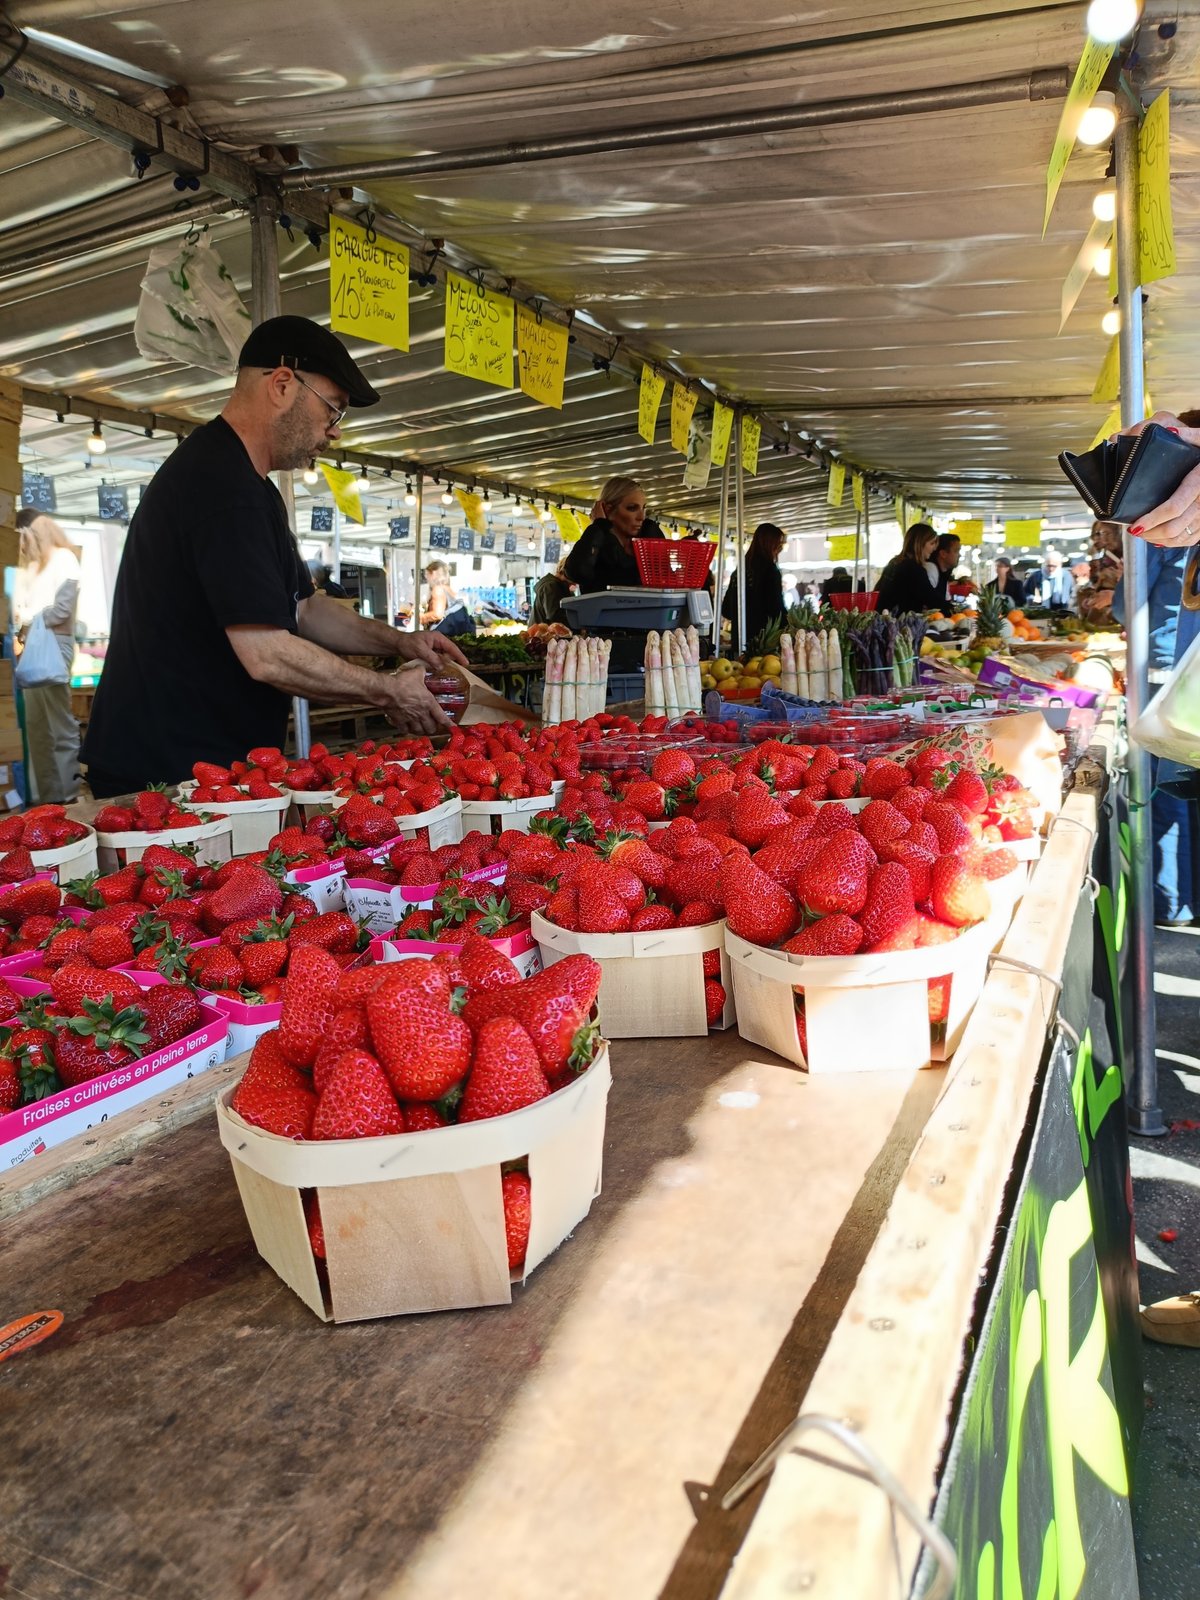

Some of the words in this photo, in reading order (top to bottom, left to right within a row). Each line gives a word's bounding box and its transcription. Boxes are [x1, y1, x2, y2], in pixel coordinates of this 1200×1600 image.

[334, 227, 407, 275] GARIGUETTES
[450, 281, 500, 324] MELONS
[520, 313, 557, 351] ANANAS
[22, 1099, 71, 1127] Fraises
[73, 1071, 132, 1104] cultivées
[134, 1065, 150, 1078] en
[151, 1047, 185, 1074] pleine
[186, 1032, 209, 1051] terre
[10, 1135, 43, 1166] Produites
